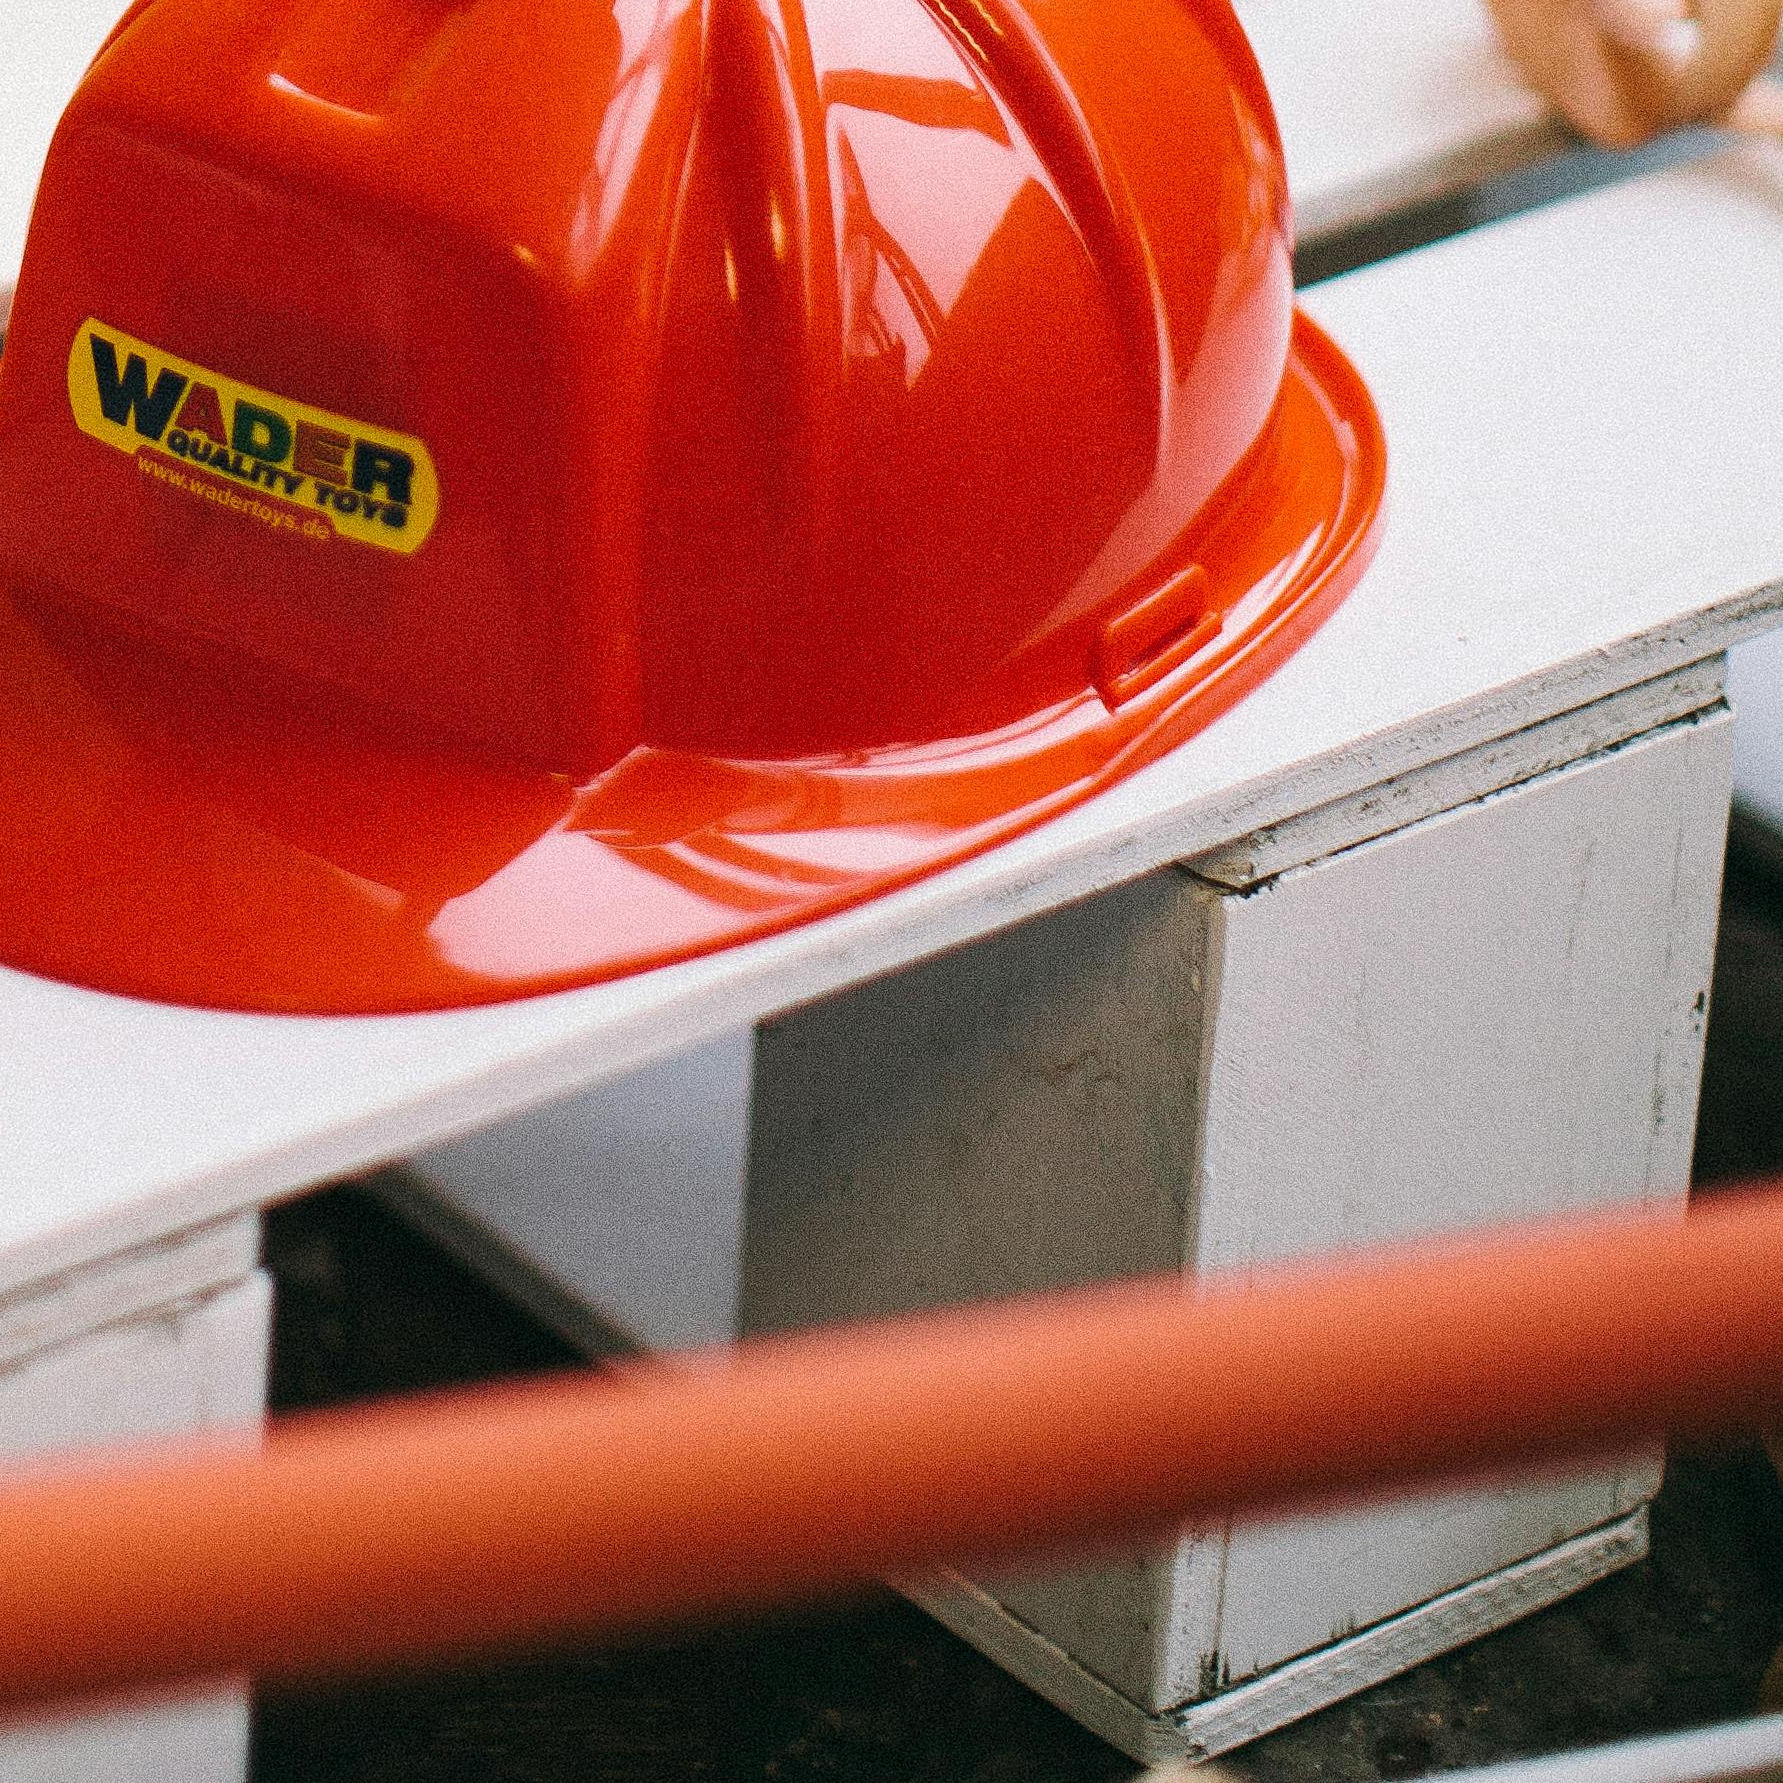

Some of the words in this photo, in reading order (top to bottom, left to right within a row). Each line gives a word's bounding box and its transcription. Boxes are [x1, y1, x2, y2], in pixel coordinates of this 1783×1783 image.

[89, 332, 415, 504] WADER
[137, 455, 331, 540] www.wadertoys.de
[167, 429, 304, 495] QUALITY
[316, 482, 409, 529] TOYS
